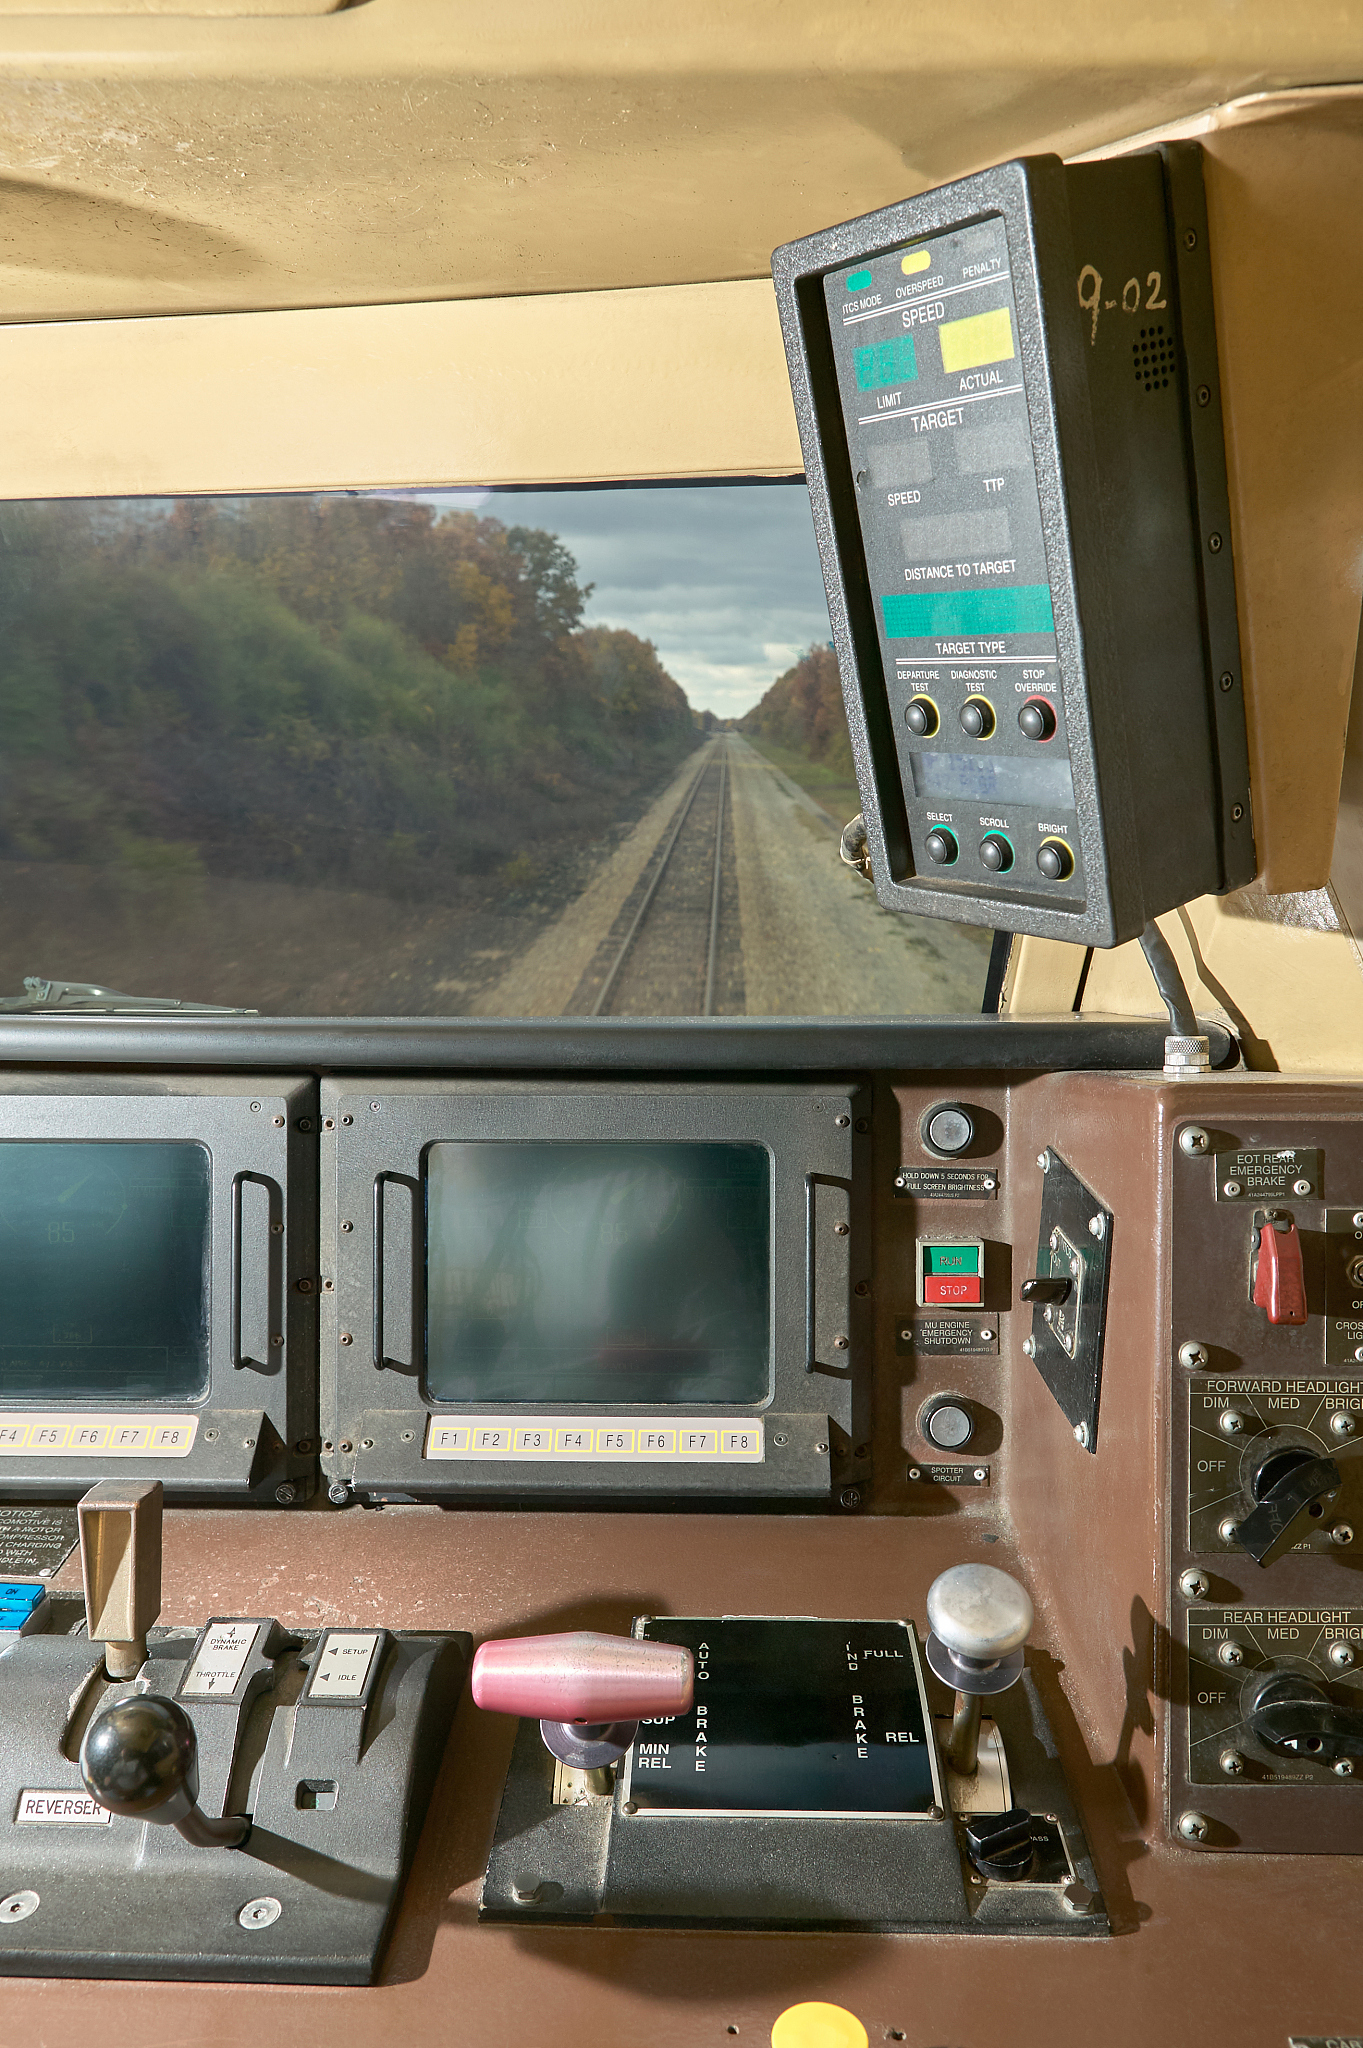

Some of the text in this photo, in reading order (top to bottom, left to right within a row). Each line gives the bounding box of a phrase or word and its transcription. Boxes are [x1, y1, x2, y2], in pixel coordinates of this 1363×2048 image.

[962, 258, 1002, 279] PENALTY
[896, 275, 944, 299] OVERSPEED
[842, 294, 882, 315] ITCS MODE
[1077, 264, 1167, 346] 9-02
[901, 302, 945, 328] SPEED
[959, 370, 1003, 391] ACTUAL
[876, 392, 902, 409] LIMIT
[910, 408, 964, 433] TARGET
[982, 478, 1005, 492] TTP
[887, 490, 921, 507] SPEED
[904, 560, 1017, 581] DISTANCE TO TARGET
[935, 641, 1006, 655] TARGET TYPE
[897, 670, 940, 680] DEPARTURE
[951, 670, 997, 680] DIAGNOSTIC
[1022, 669, 1045, 680] STOP
[911, 682, 929, 692] TEST
[965, 682, 985, 692] TEST
[1015, 682, 1057, 693] OVERRIDE
[926, 812, 953, 823] SELECT
[979, 816, 1010, 829] SCROLL
[1038, 822, 1068, 835] BRIGHT
[1237, 1154, 1295, 1164] EOT REAR
[1229, 1164, 1303, 1176] EMERGENCY
[902, 1172, 919, 1180] HOLD
[920, 1172, 939, 1180] DOWN
[940, 1172, 945, 1180] 5
[947, 1173, 975, 1181] SECONDS
[1247, 1176, 1286, 1187] BRAKE
[923, 1183, 946, 1191] SCREEN
[947, 1183, 985, 1192] BRIGHTNESS
[939, 1255, 962, 1266] RUN
[940, 1285, 967, 1295] STOP
[924, 1321, 970, 1329] MU ENGINE
[924, 1337, 971, 1345] SHUTDOWN
[1207, 1381, 1281, 1393] FORWARD
[1203, 1397, 1363, 1410] DIM MED BRIG
[39, 1430, 58, 1442] F5
[79, 1430, 99, 1443] F6
[120, 1431, 139, 1443] F7
[160, 1431, 180, 1444] F8
[440, 1433, 748, 1448] F1 F2 F3 F4 F5 F6 F7 F8
[1197, 1460, 1226, 1472] OFF
[0, 1510, 42, 1518] OTICE
[5, 1541, 62, 1549] CHARGING
[1223, 1611, 1351, 1623] REAR HEADLIGHT
[1202, 1627, 1363, 1640] DIM MED BRIG
[863, 1649, 904, 1659] FULL
[846, 1641, 869, 1759] IND BRAKE
[1197, 1692, 1226, 1704] OFF
[695, 1642, 710, 1772] AUTO BRAKE
[885, 1732, 920, 1743] REL
[639, 1743, 670, 1755] MIN
[638, 1757, 672, 1769] REL
[25, 1799, 101, 1815] REVERSER
